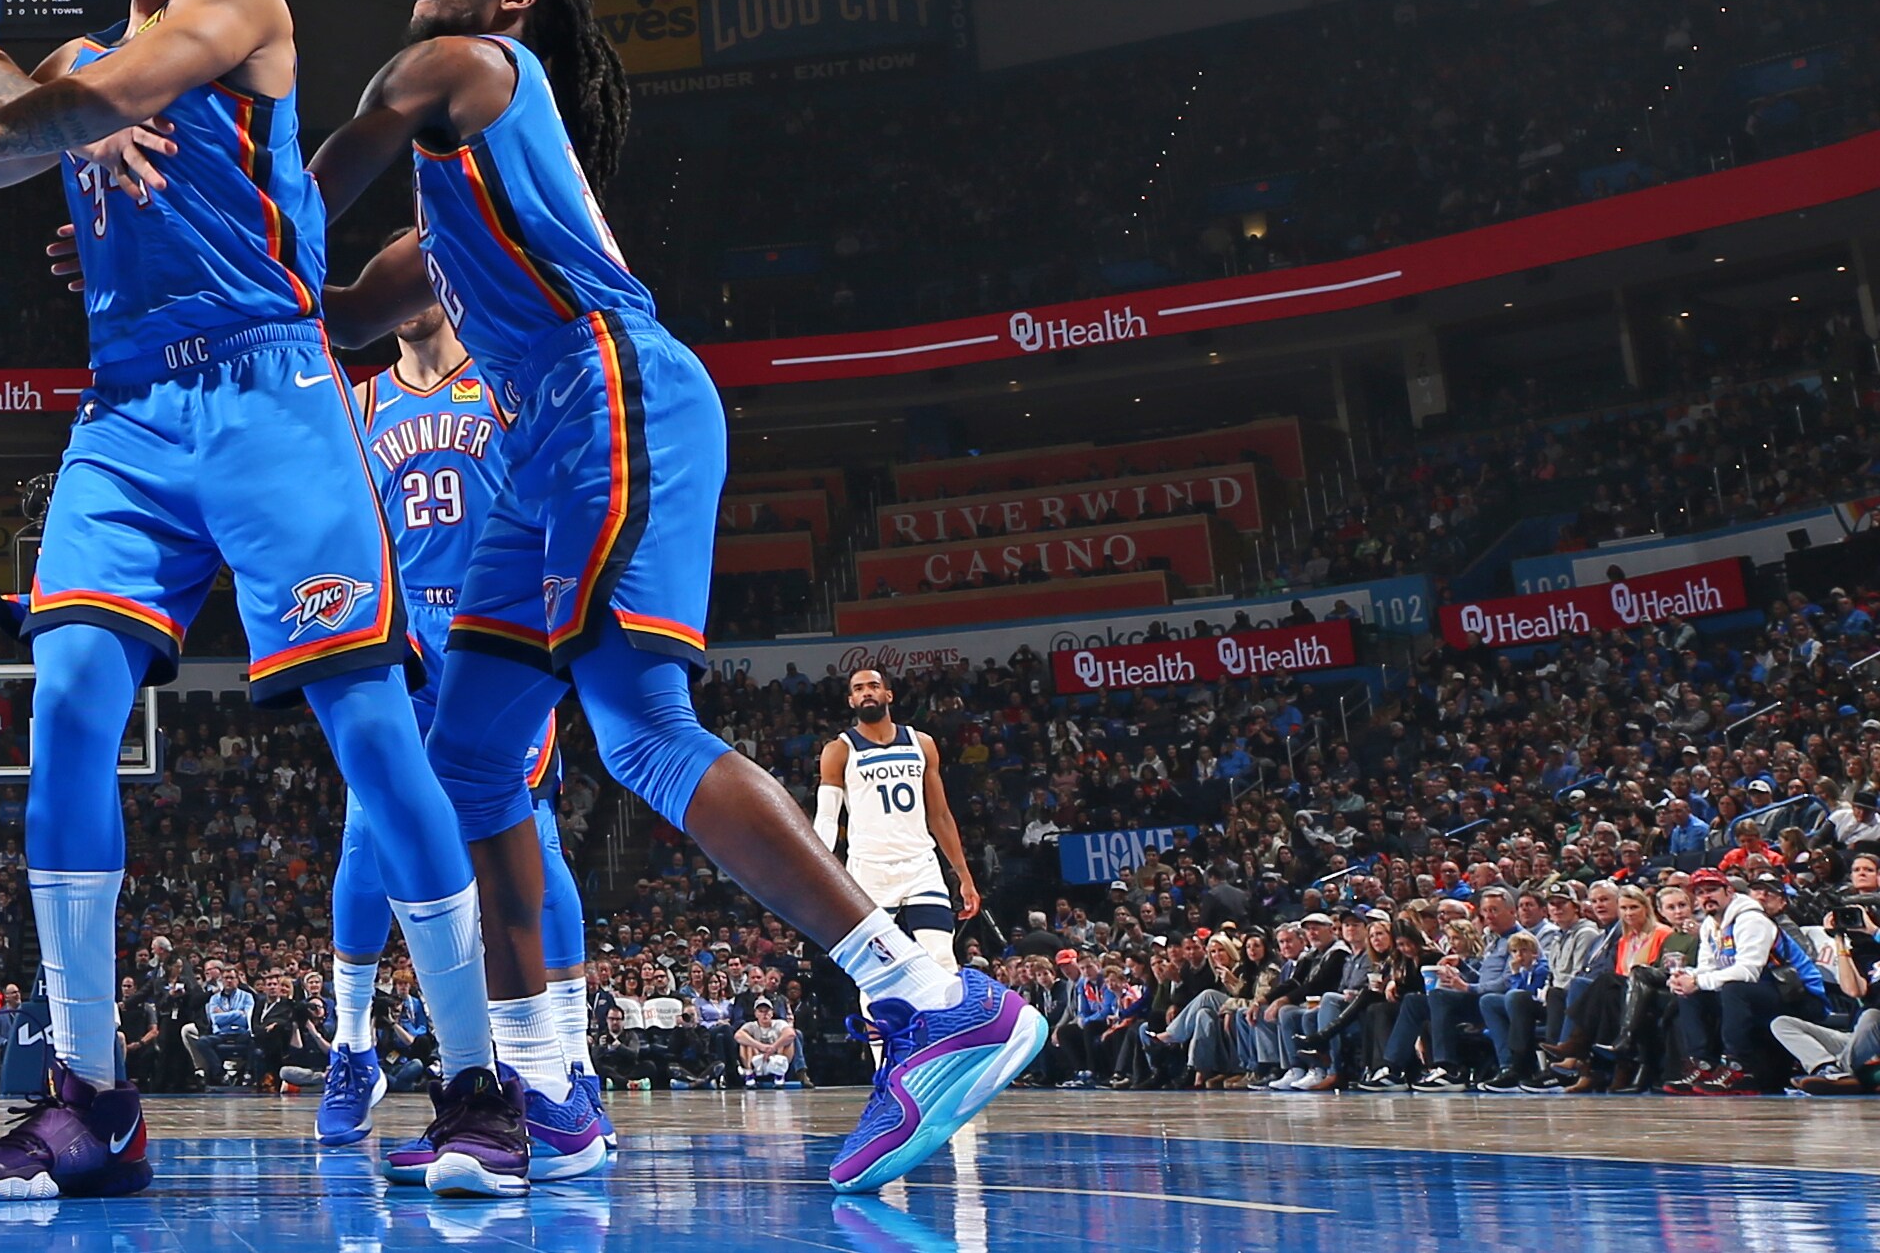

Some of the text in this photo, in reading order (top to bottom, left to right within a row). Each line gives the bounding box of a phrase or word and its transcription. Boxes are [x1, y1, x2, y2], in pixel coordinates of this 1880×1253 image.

[636, 51, 918, 98] THUNDER EXIT NOW
[1009, 306, 1148, 352] OU Health
[165, 337, 208, 369] OKC
[372, 414, 493, 472] THUNDER
[402, 468, 464, 529] 29
[892, 475, 1244, 544] RIVERWIND
[923, 533, 1138, 586] CASINO
[304, 584, 342, 621] OKC
[426, 588, 454, 605] OKC
[1376, 594, 1424, 627] 102
[1495, 602, 1590, 643] Health
[1611, 583, 1639, 624] OU
[1640, 577, 1723, 621] Health
[838, 644, 959, 680] Bally SPORTS
[1073, 635, 1332, 688] OU Health OU Health
[860, 764, 921, 782] WOLVES
[876, 782, 916, 815] 10
